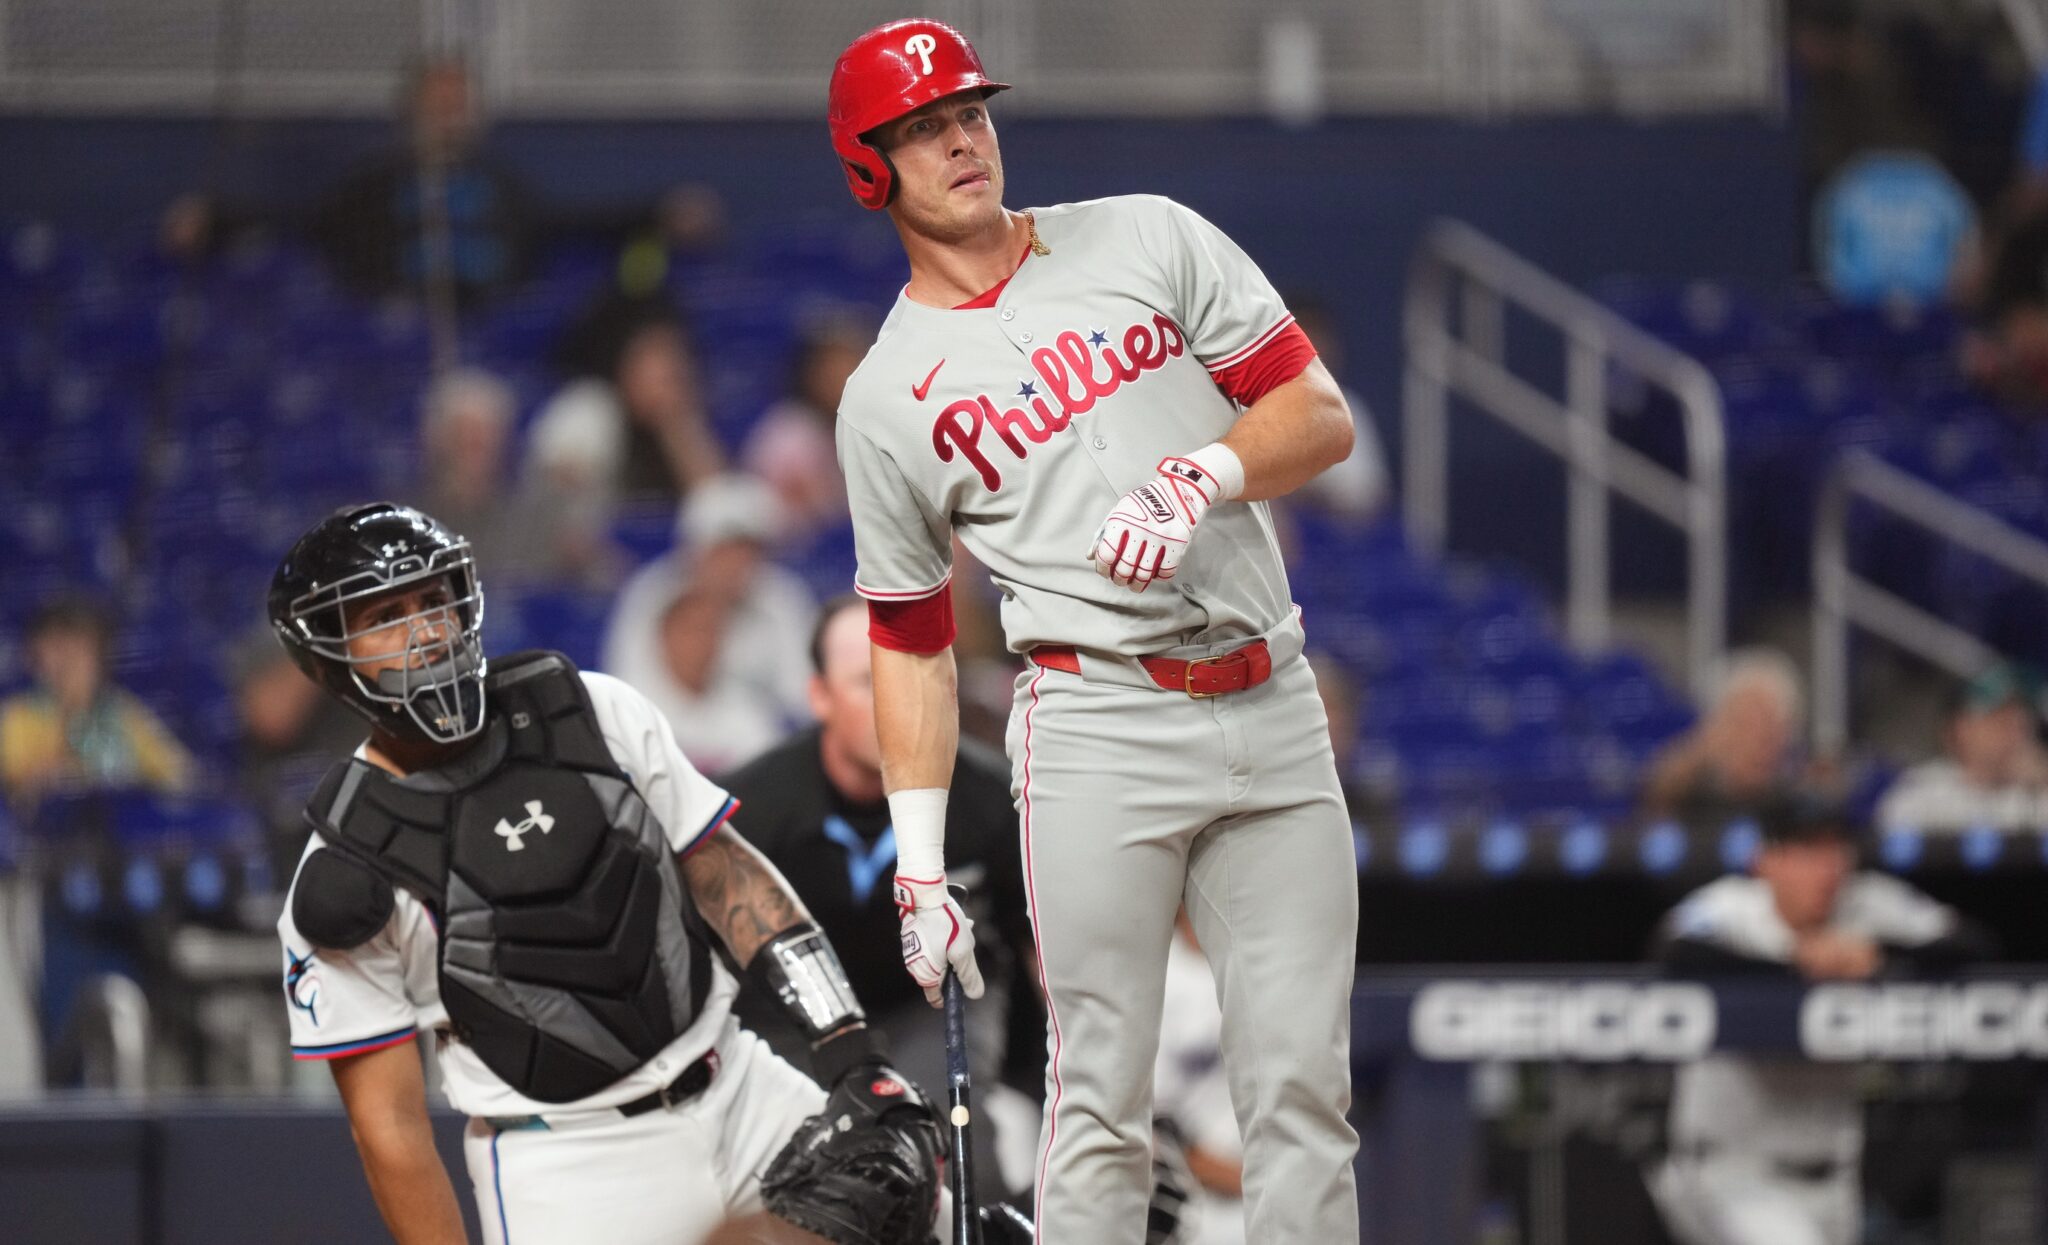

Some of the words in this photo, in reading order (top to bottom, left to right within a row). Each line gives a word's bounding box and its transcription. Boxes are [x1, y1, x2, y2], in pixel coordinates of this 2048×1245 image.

[905, 34, 936, 75] P
[932, 312, 1184, 493] Phillies
[1412, 982, 1716, 1060] GEICO
[1801, 982, 2048, 1060] GEIC
